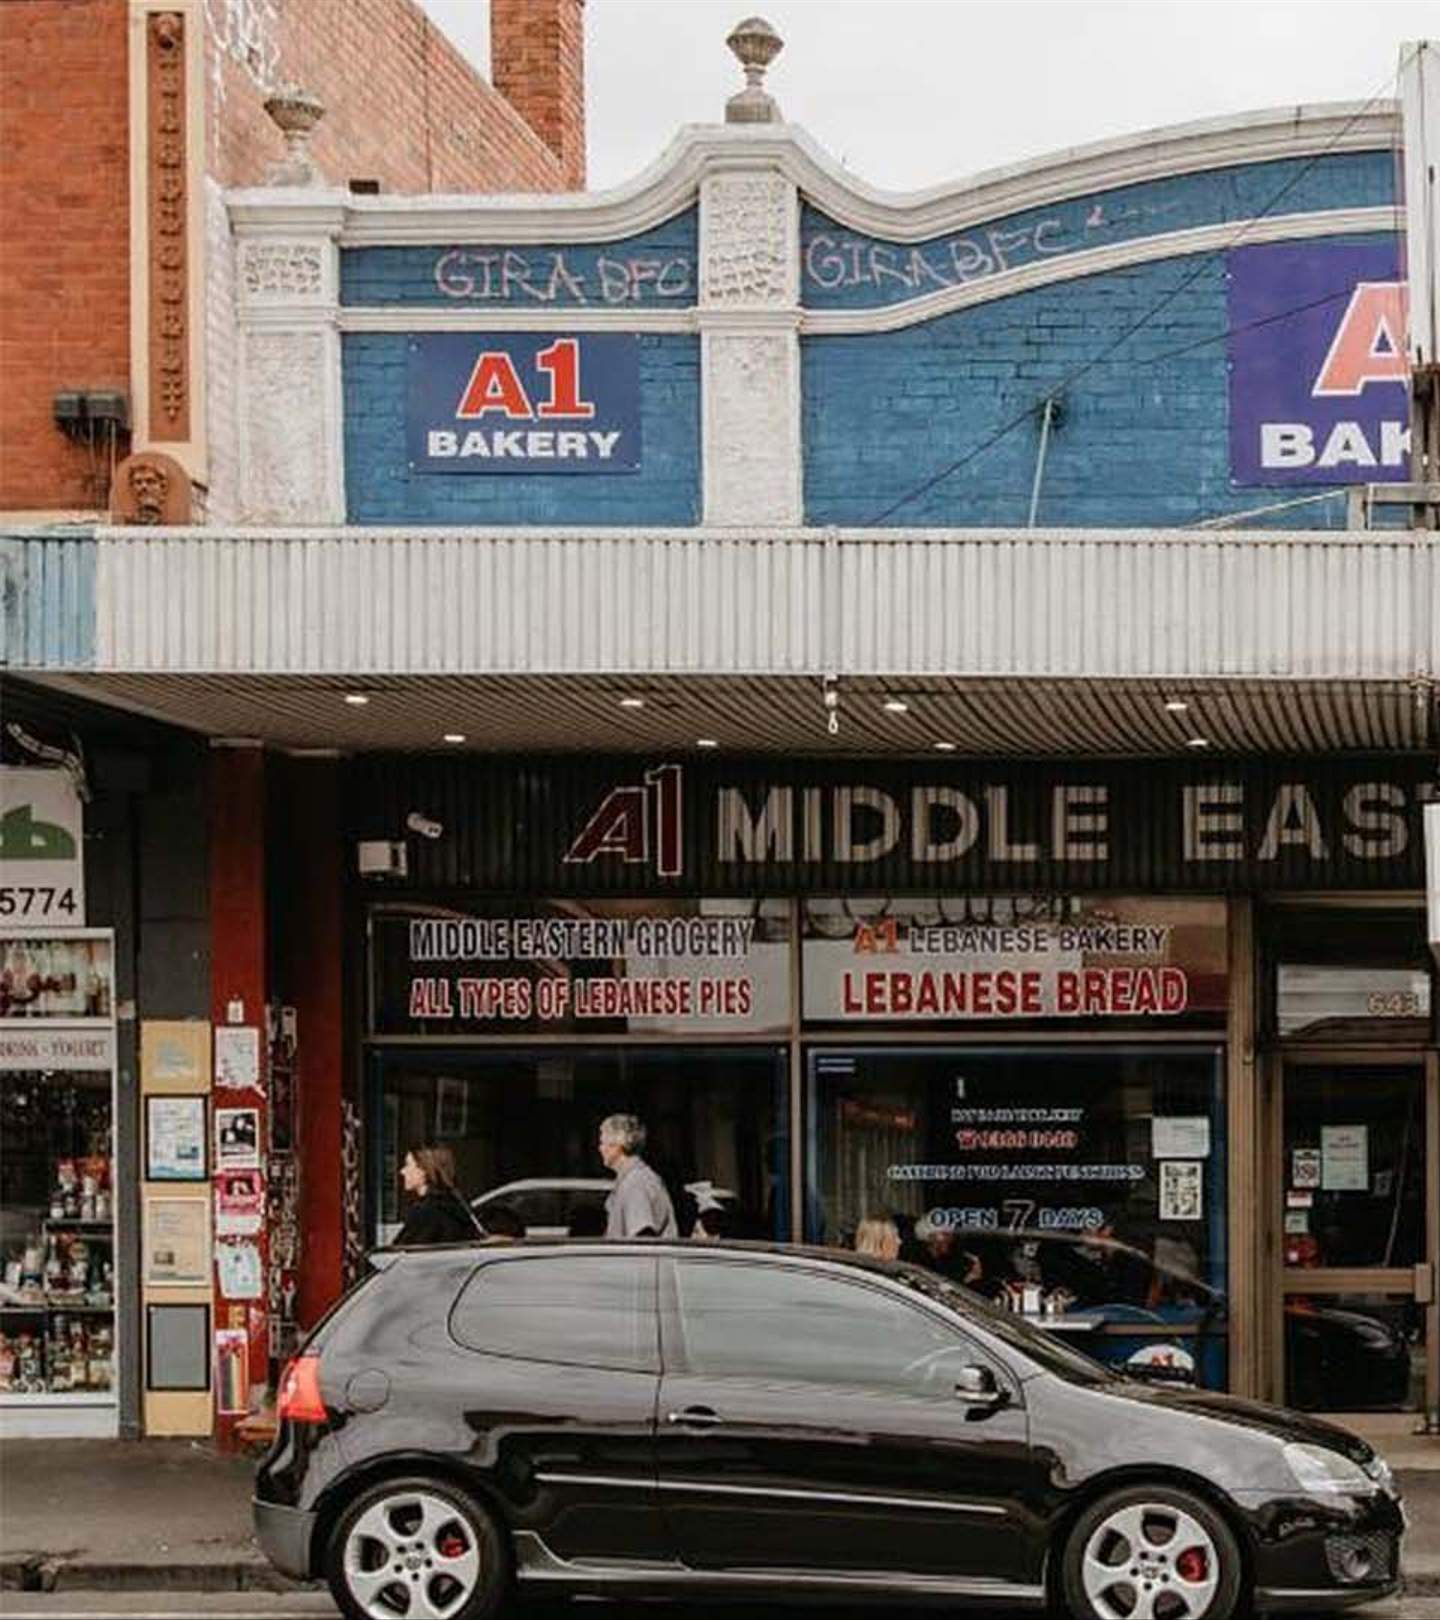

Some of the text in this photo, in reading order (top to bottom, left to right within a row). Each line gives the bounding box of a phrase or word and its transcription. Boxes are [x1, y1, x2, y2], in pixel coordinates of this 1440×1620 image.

[434, 250, 587, 304] GIRA
[456, 338, 595, 419] A1
[427, 430, 622, 458] BAKERY
[562, 764, 682, 876] A1
[718, 786, 1109, 862] MIDDLE
[0, 887, 76, 916] 5774
[410, 918, 754, 960] MIDDLE EASTERN GROCERY
[853, 917, 1168, 954] A1 LEBANESE BAKERY
[409, 977, 754, 1019] ALL TYPES OF LEBANESE PIES
[841, 967, 1187, 1015] LEBANESE BREAD
[930, 1199, 1105, 1234] OPEN 7 DAYS
